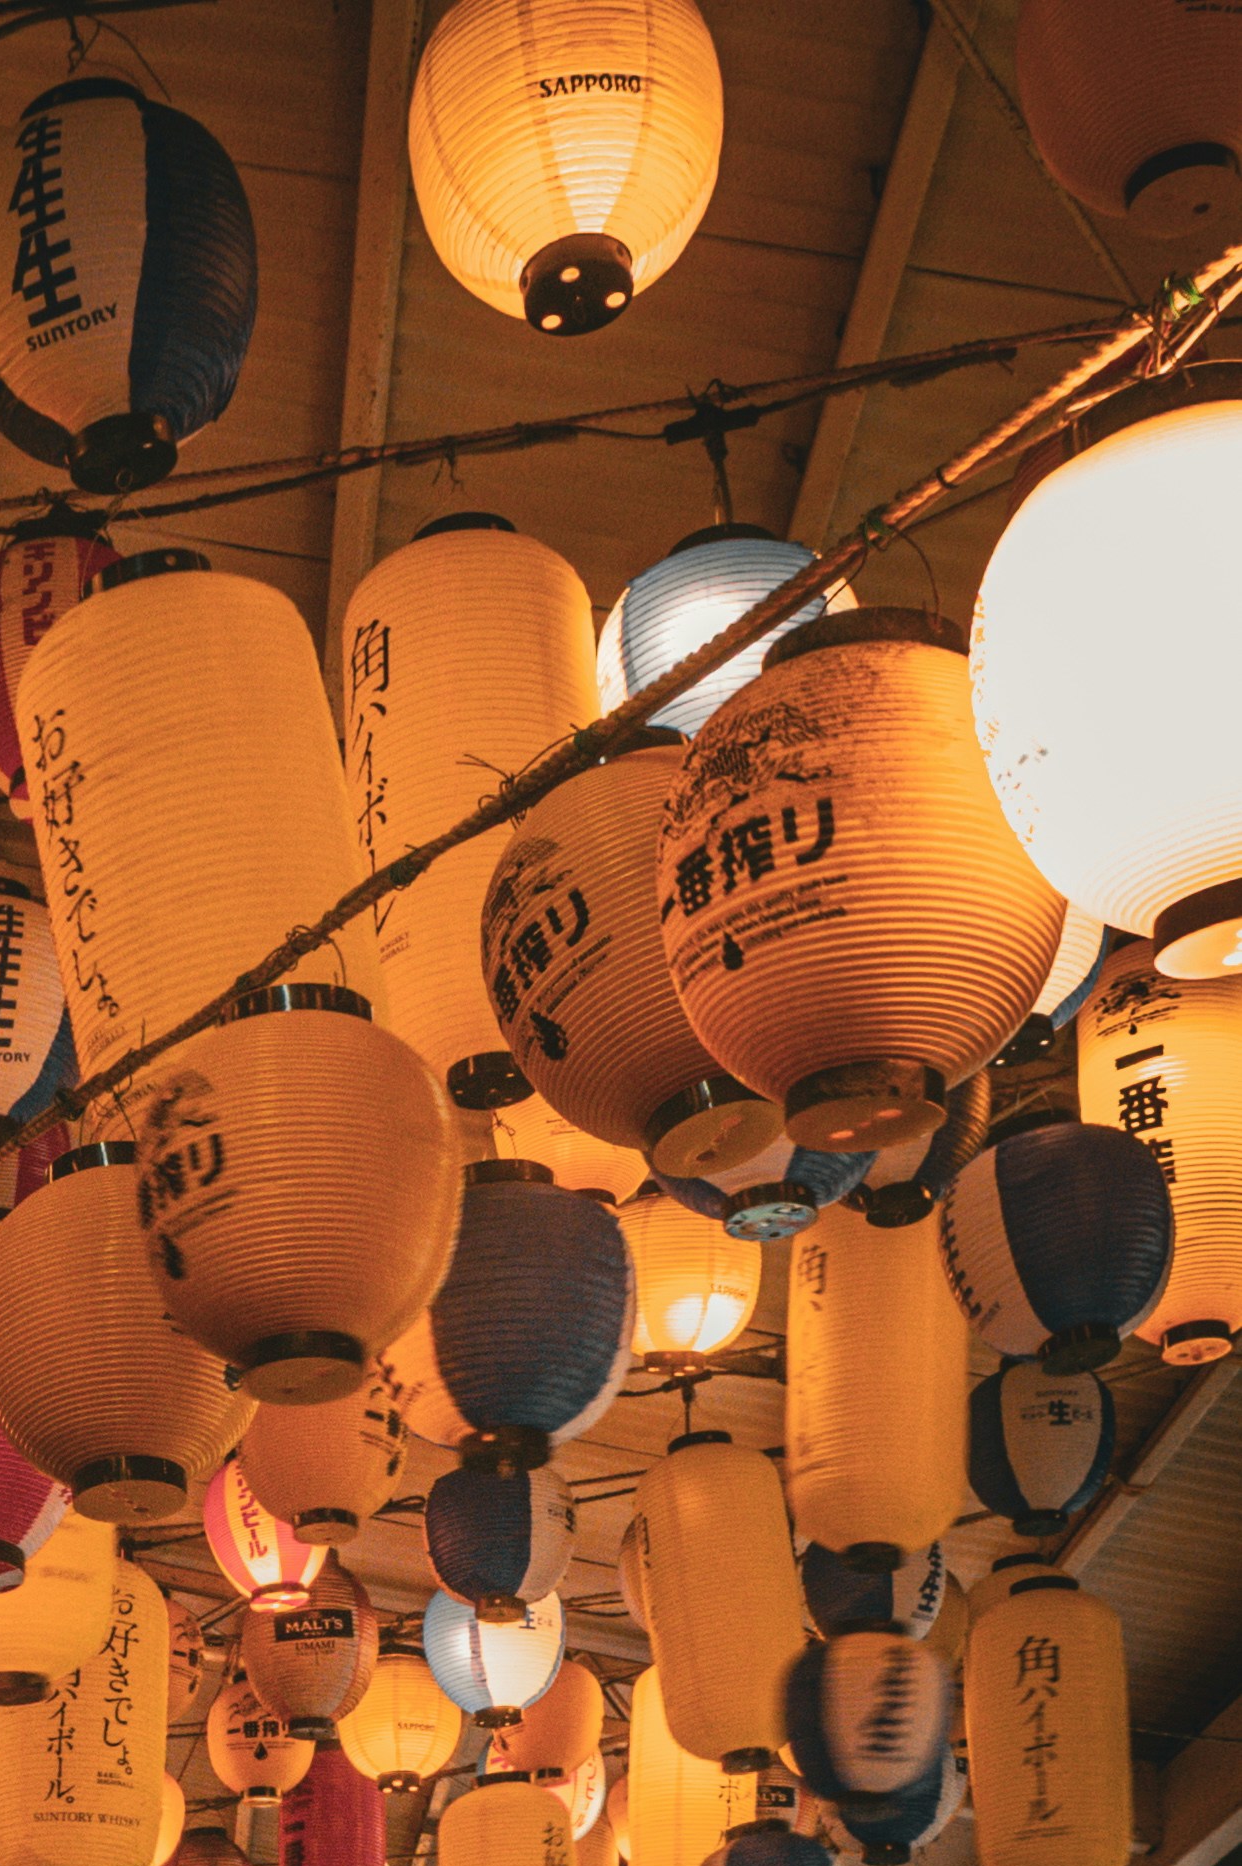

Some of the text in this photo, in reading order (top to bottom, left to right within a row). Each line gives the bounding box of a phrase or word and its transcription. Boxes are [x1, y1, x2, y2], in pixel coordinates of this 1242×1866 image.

[538, 72, 642, 99] SAPPORO
[9, 116, 83, 328] 生生生
[25, 302, 119, 353] SUNTORY
[285, 1617, 345, 1635] MALT'S
[1013, 1633, 1063, 1823] 角ハイボール
[32, 1811, 142, 1829] SUNTORY WHISKY
